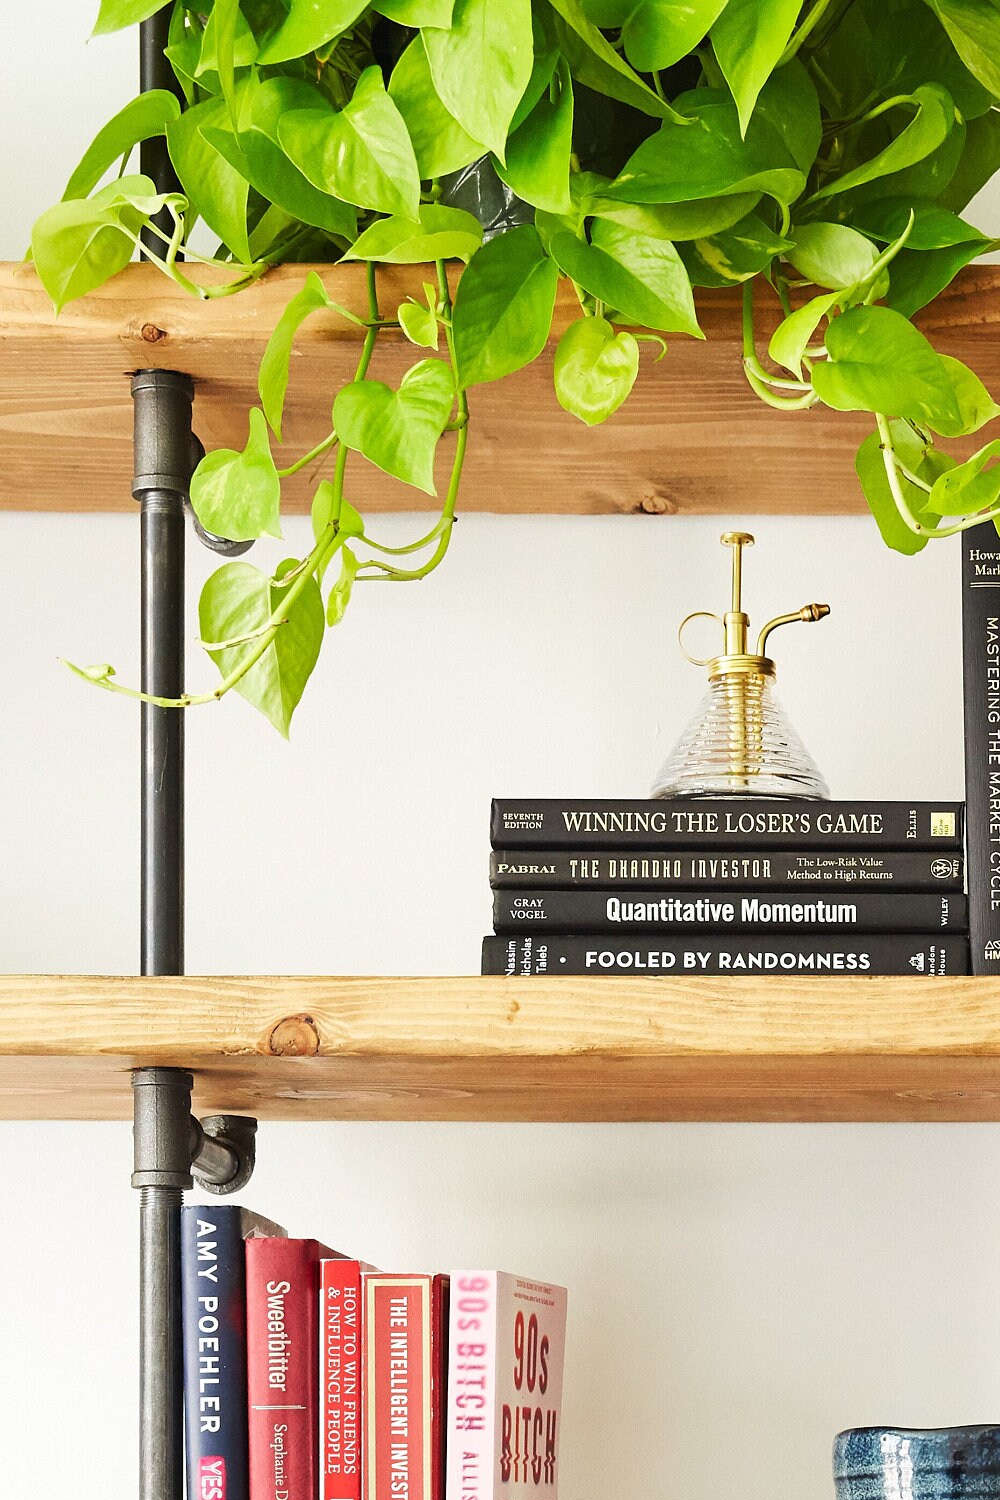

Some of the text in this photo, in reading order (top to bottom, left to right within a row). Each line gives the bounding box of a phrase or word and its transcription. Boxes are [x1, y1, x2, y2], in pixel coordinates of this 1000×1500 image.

[987, 618, 1000, 722] MASTERING
[989, 730, 1000, 764] THE
[562, 812, 883, 833] WINNING THE LOSER'S GAME
[497, 864, 555, 874] PABRAI
[570, 859, 771, 878] THE DHANDHO INVESTOR
[787, 870, 821, 879] Method
[835, 870, 856, 882] High
[860, 870, 892, 879] Returns
[797, 858, 883, 866] The Low-Risk Value
[607, 898, 856, 922] Quantitative Momentum
[586, 952, 870, 969] FOOLED BY RANDOMNESS
[196, 1219, 221, 1433] AMY POEHLER
[391, 1297, 408, 1327] THE
[265, 1281, 291, 1391] Sweetbitter
[328, 1287, 340, 1473] & INFLUENCE PEOPLE
[344, 1288, 356, 1474] HOW TO WIN FRIENDS
[391, 1333, 408, 1437] INTELLIGENT
[270, 1423, 288, 1485] Stephanie
[200, 1460, 223, 1500] YES
